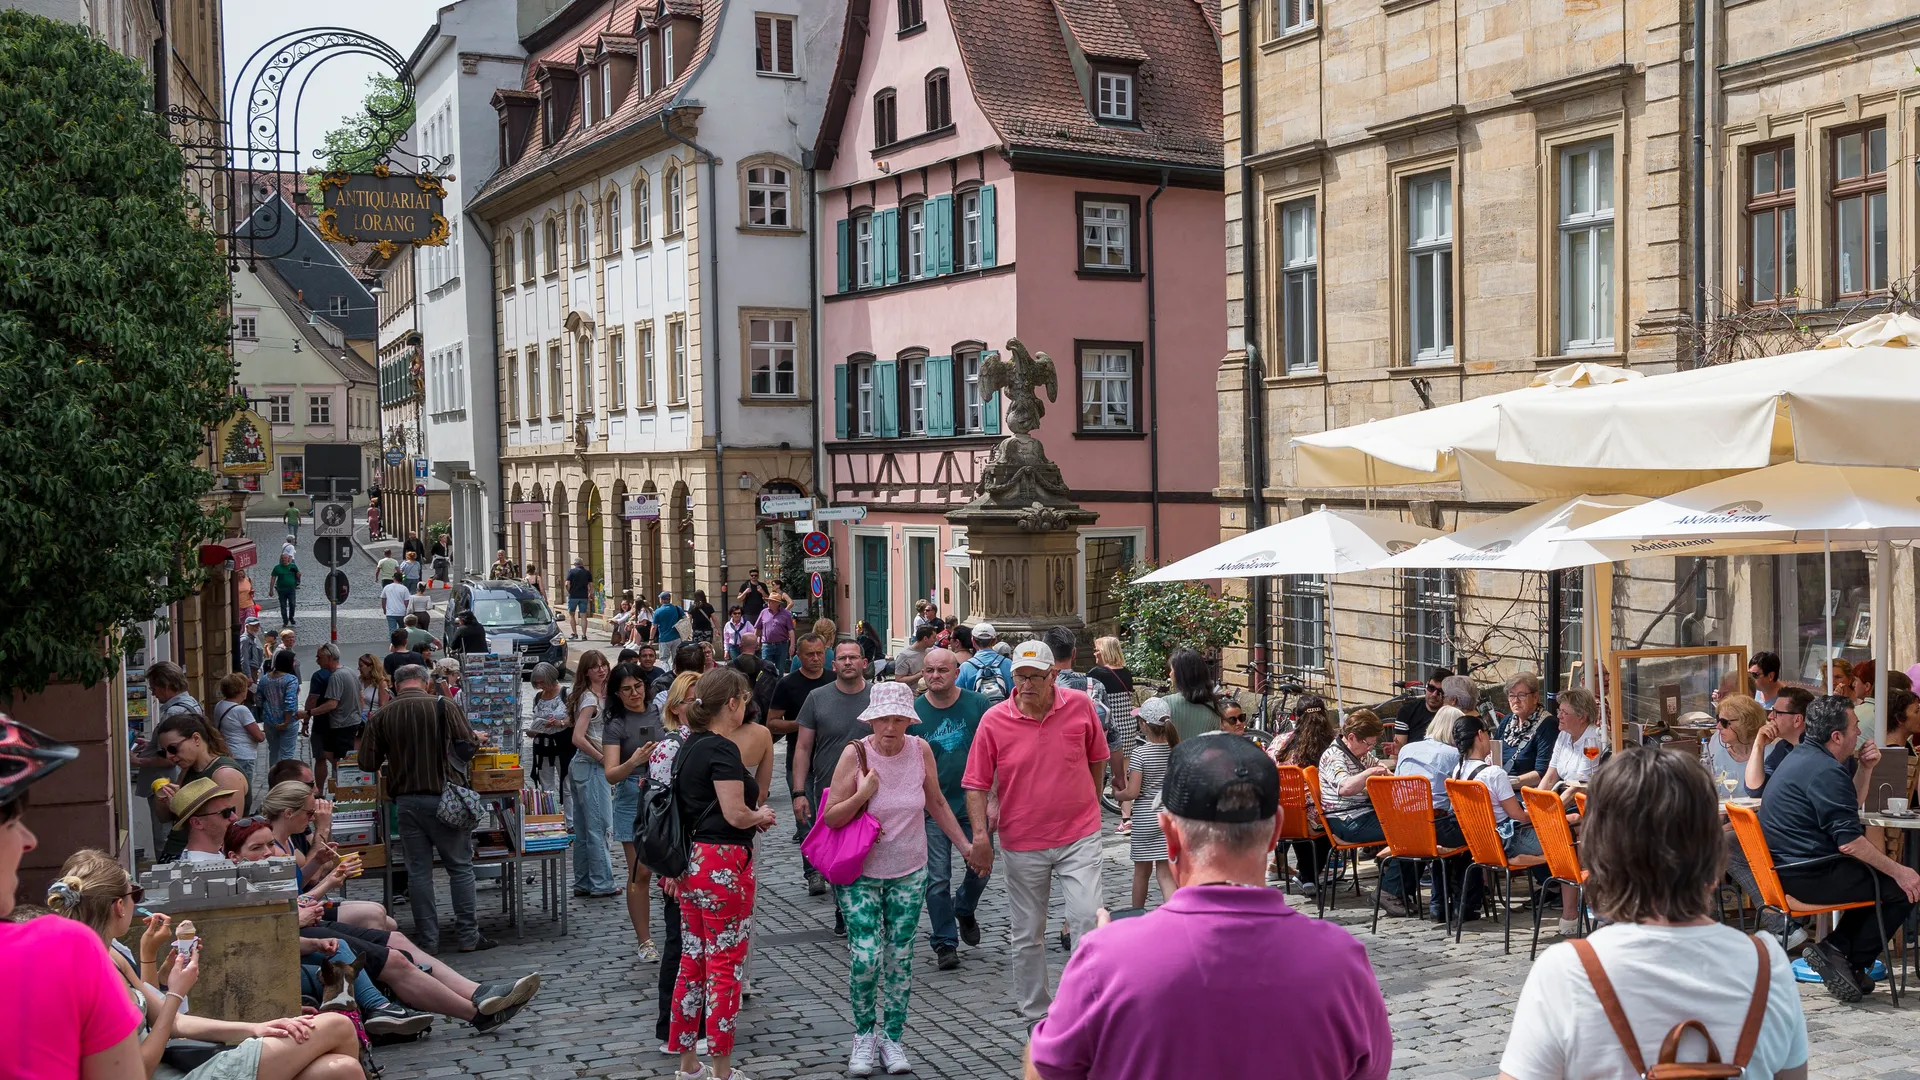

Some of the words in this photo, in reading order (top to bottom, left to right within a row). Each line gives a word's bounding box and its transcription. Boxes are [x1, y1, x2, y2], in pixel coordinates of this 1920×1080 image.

[336, 190, 431, 210] ANTIQUARIAT
[354, 213, 415, 232] LORANG
[1670, 514, 1771, 525] Adelholzener
[1631, 538, 1714, 552] Adelholzener
